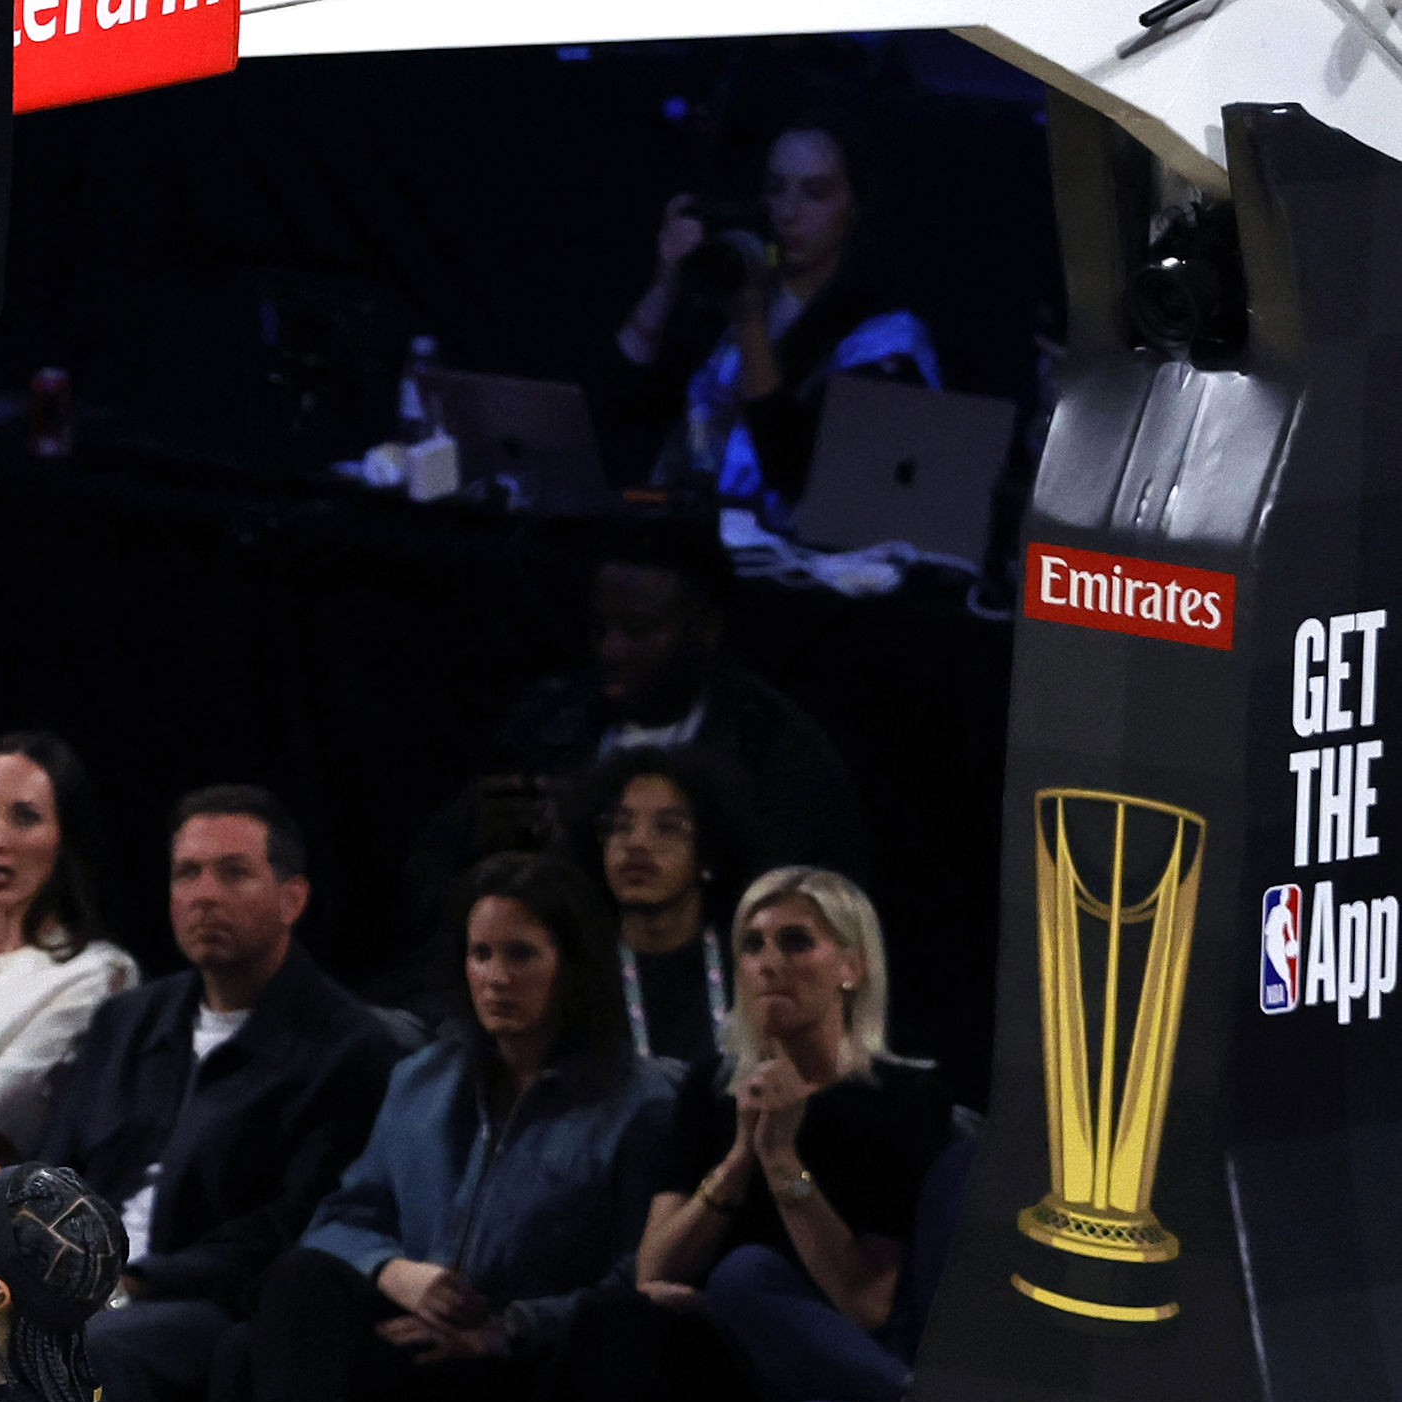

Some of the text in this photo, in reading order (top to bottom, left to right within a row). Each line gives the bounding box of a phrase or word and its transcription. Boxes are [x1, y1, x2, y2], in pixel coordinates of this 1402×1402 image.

[1039, 555, 1222, 630] Emirates
[1291, 609, 1387, 738] GET
[1289, 739, 1384, 867] THE
[1304, 880, 1400, 1025] App
